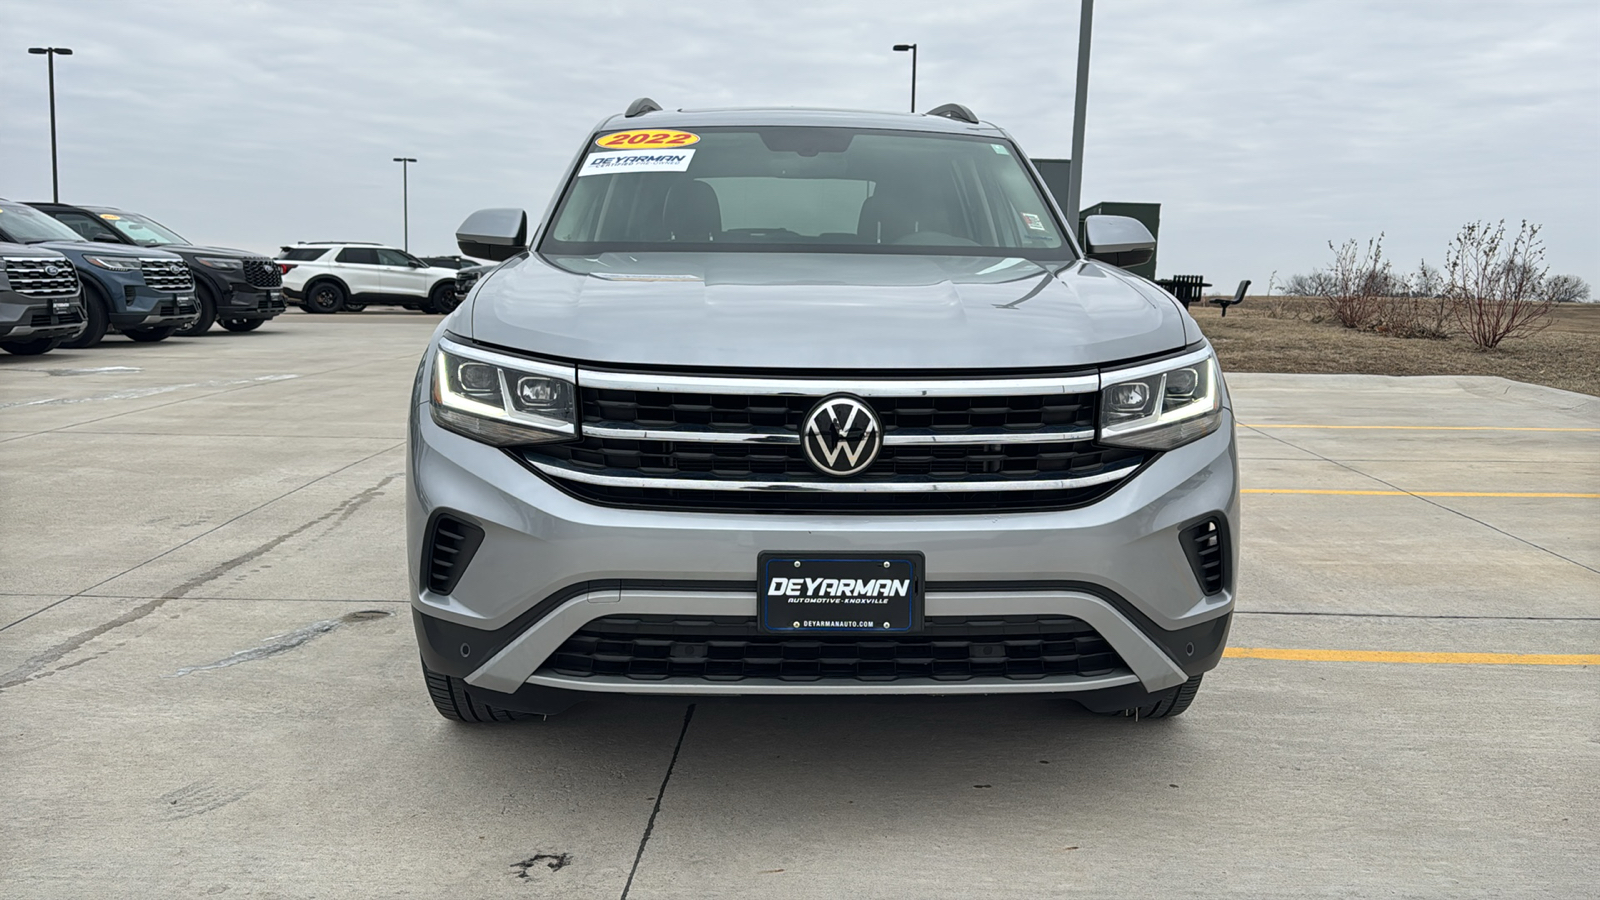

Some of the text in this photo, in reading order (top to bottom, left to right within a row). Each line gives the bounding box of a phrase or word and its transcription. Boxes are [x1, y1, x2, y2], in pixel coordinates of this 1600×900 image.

[605, 133, 692, 146] 2022
[590, 155, 686, 166] DEYARMAN
[767, 577, 911, 597] DEYARMAN
[803, 620, 874, 628] DEYARMANAUTO.COM
